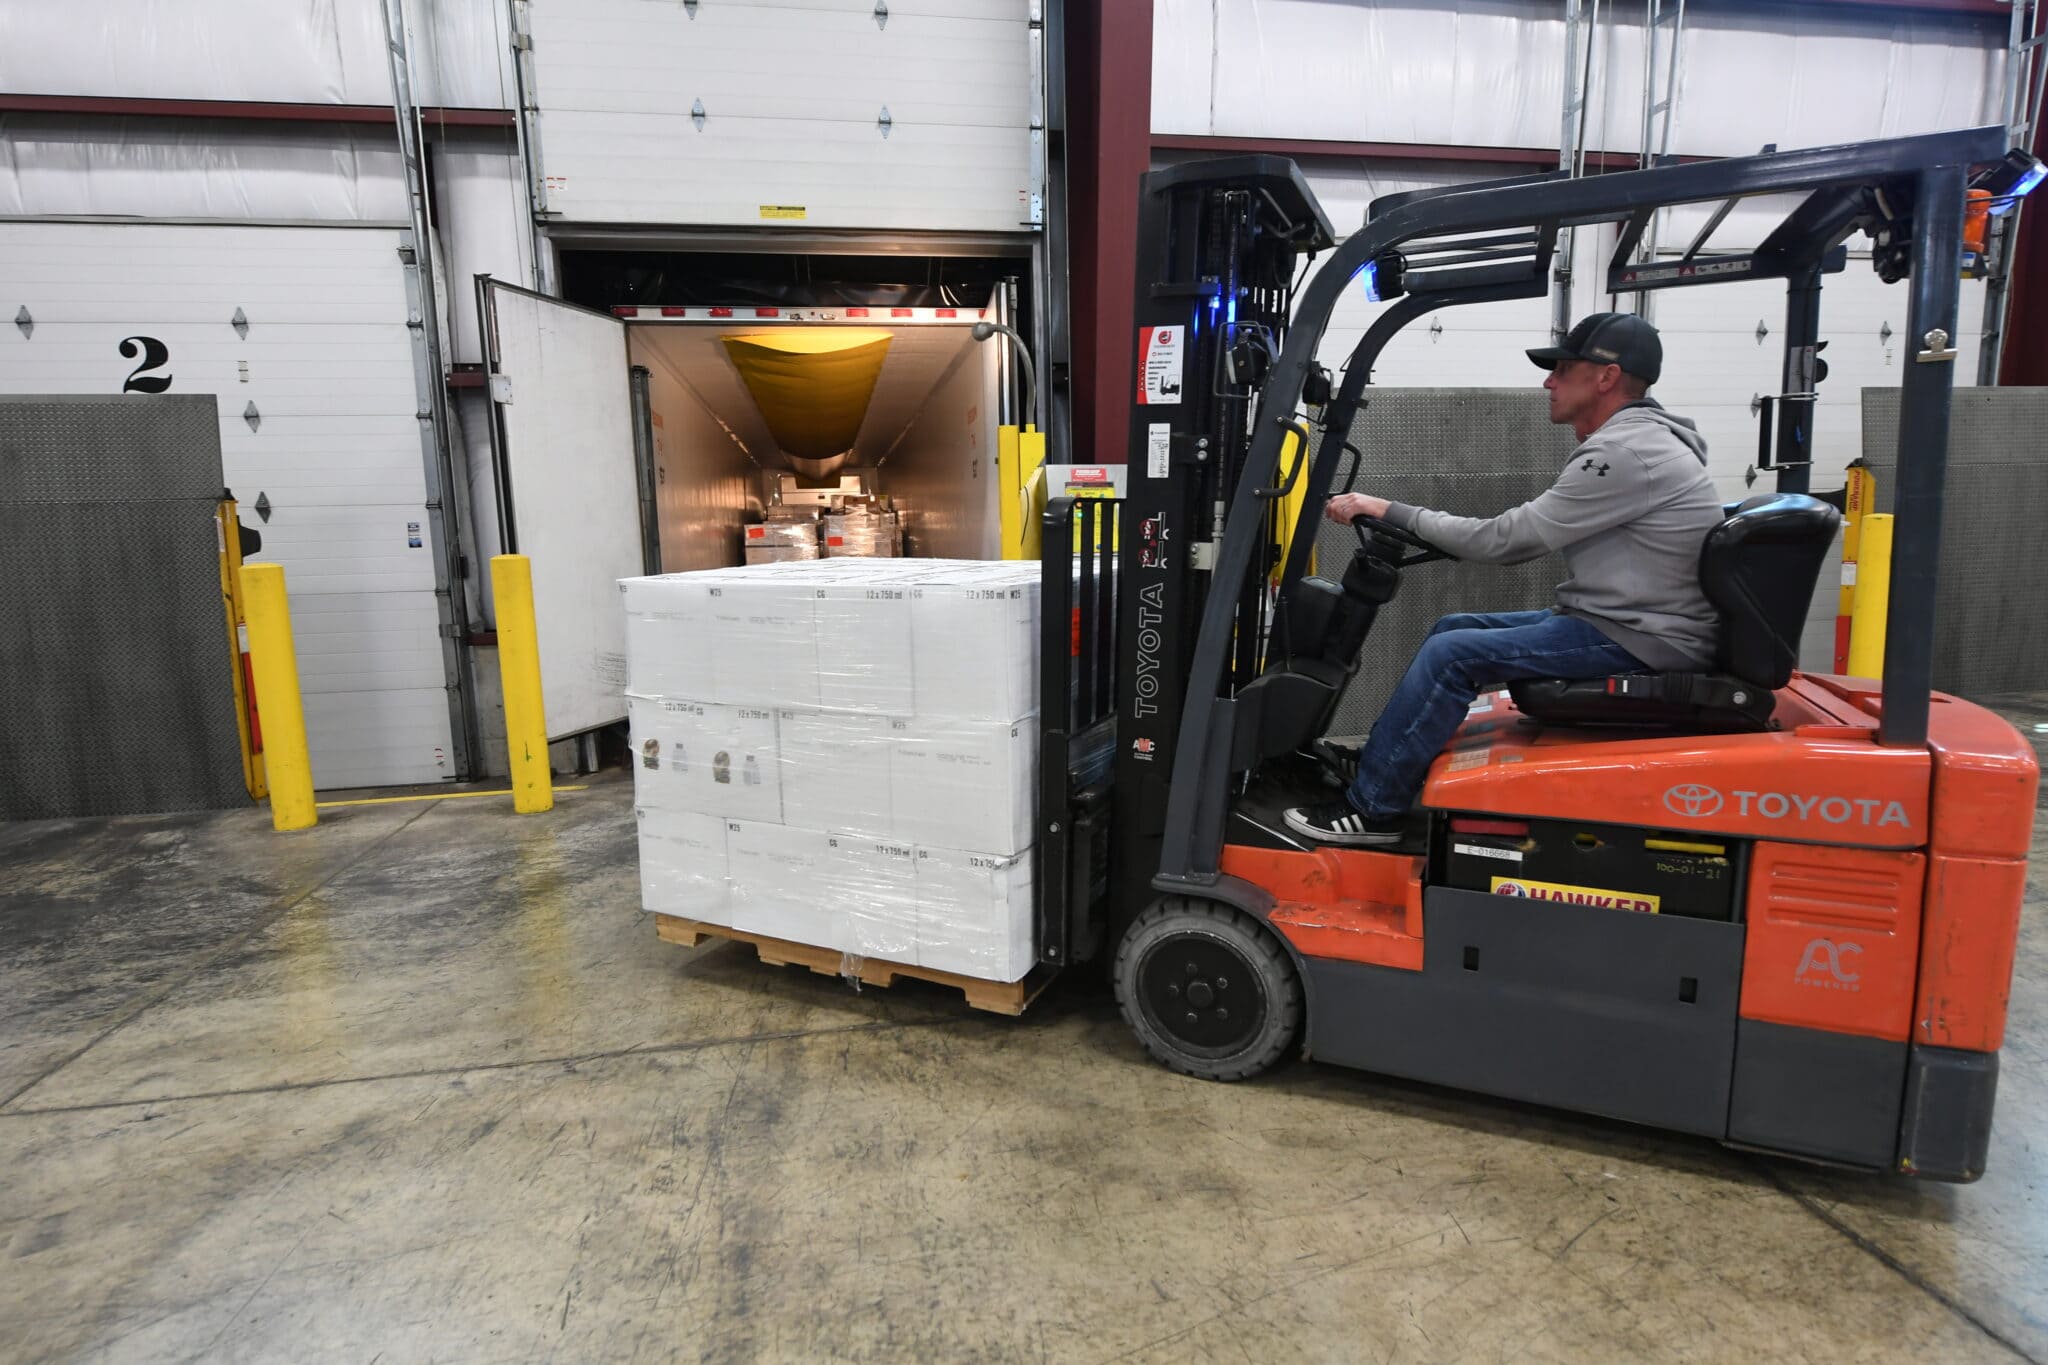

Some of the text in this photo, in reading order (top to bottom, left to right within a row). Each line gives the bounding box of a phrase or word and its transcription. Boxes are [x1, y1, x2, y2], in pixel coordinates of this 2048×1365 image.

[119, 336, 172, 394] 2
[880, 590, 894, 600] 750
[981, 589, 995, 600] 750
[996, 589, 1005, 600] ml
[1135, 583, 1163, 718] TOYOTA
[1732, 790, 1911, 828] TOYOTA
[969, 857, 979, 867] 12
[1794, 938, 1864, 982] AC
